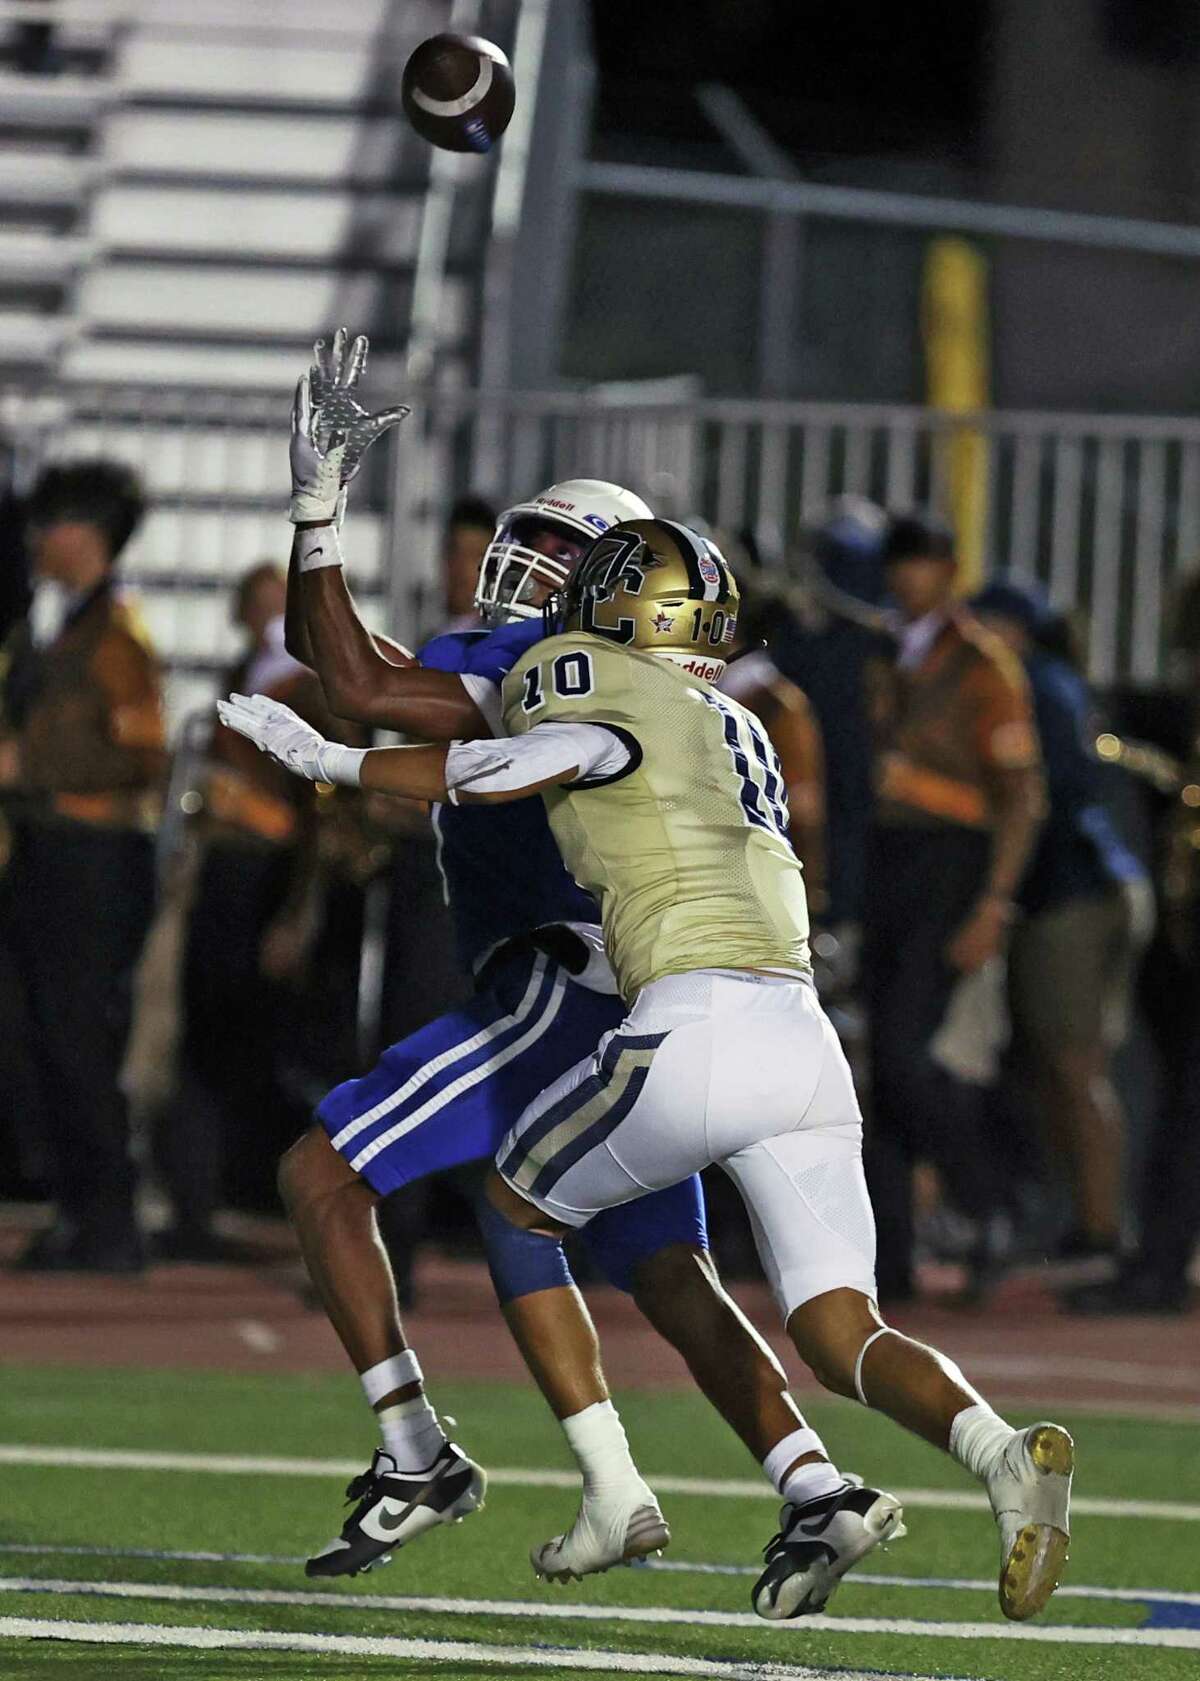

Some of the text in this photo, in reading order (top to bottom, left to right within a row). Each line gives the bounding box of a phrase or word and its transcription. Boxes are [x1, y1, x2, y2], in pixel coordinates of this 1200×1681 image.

[690, 606, 726, 646] 10
[521, 649, 595, 715] 10
[666, 658, 724, 682] ddell
